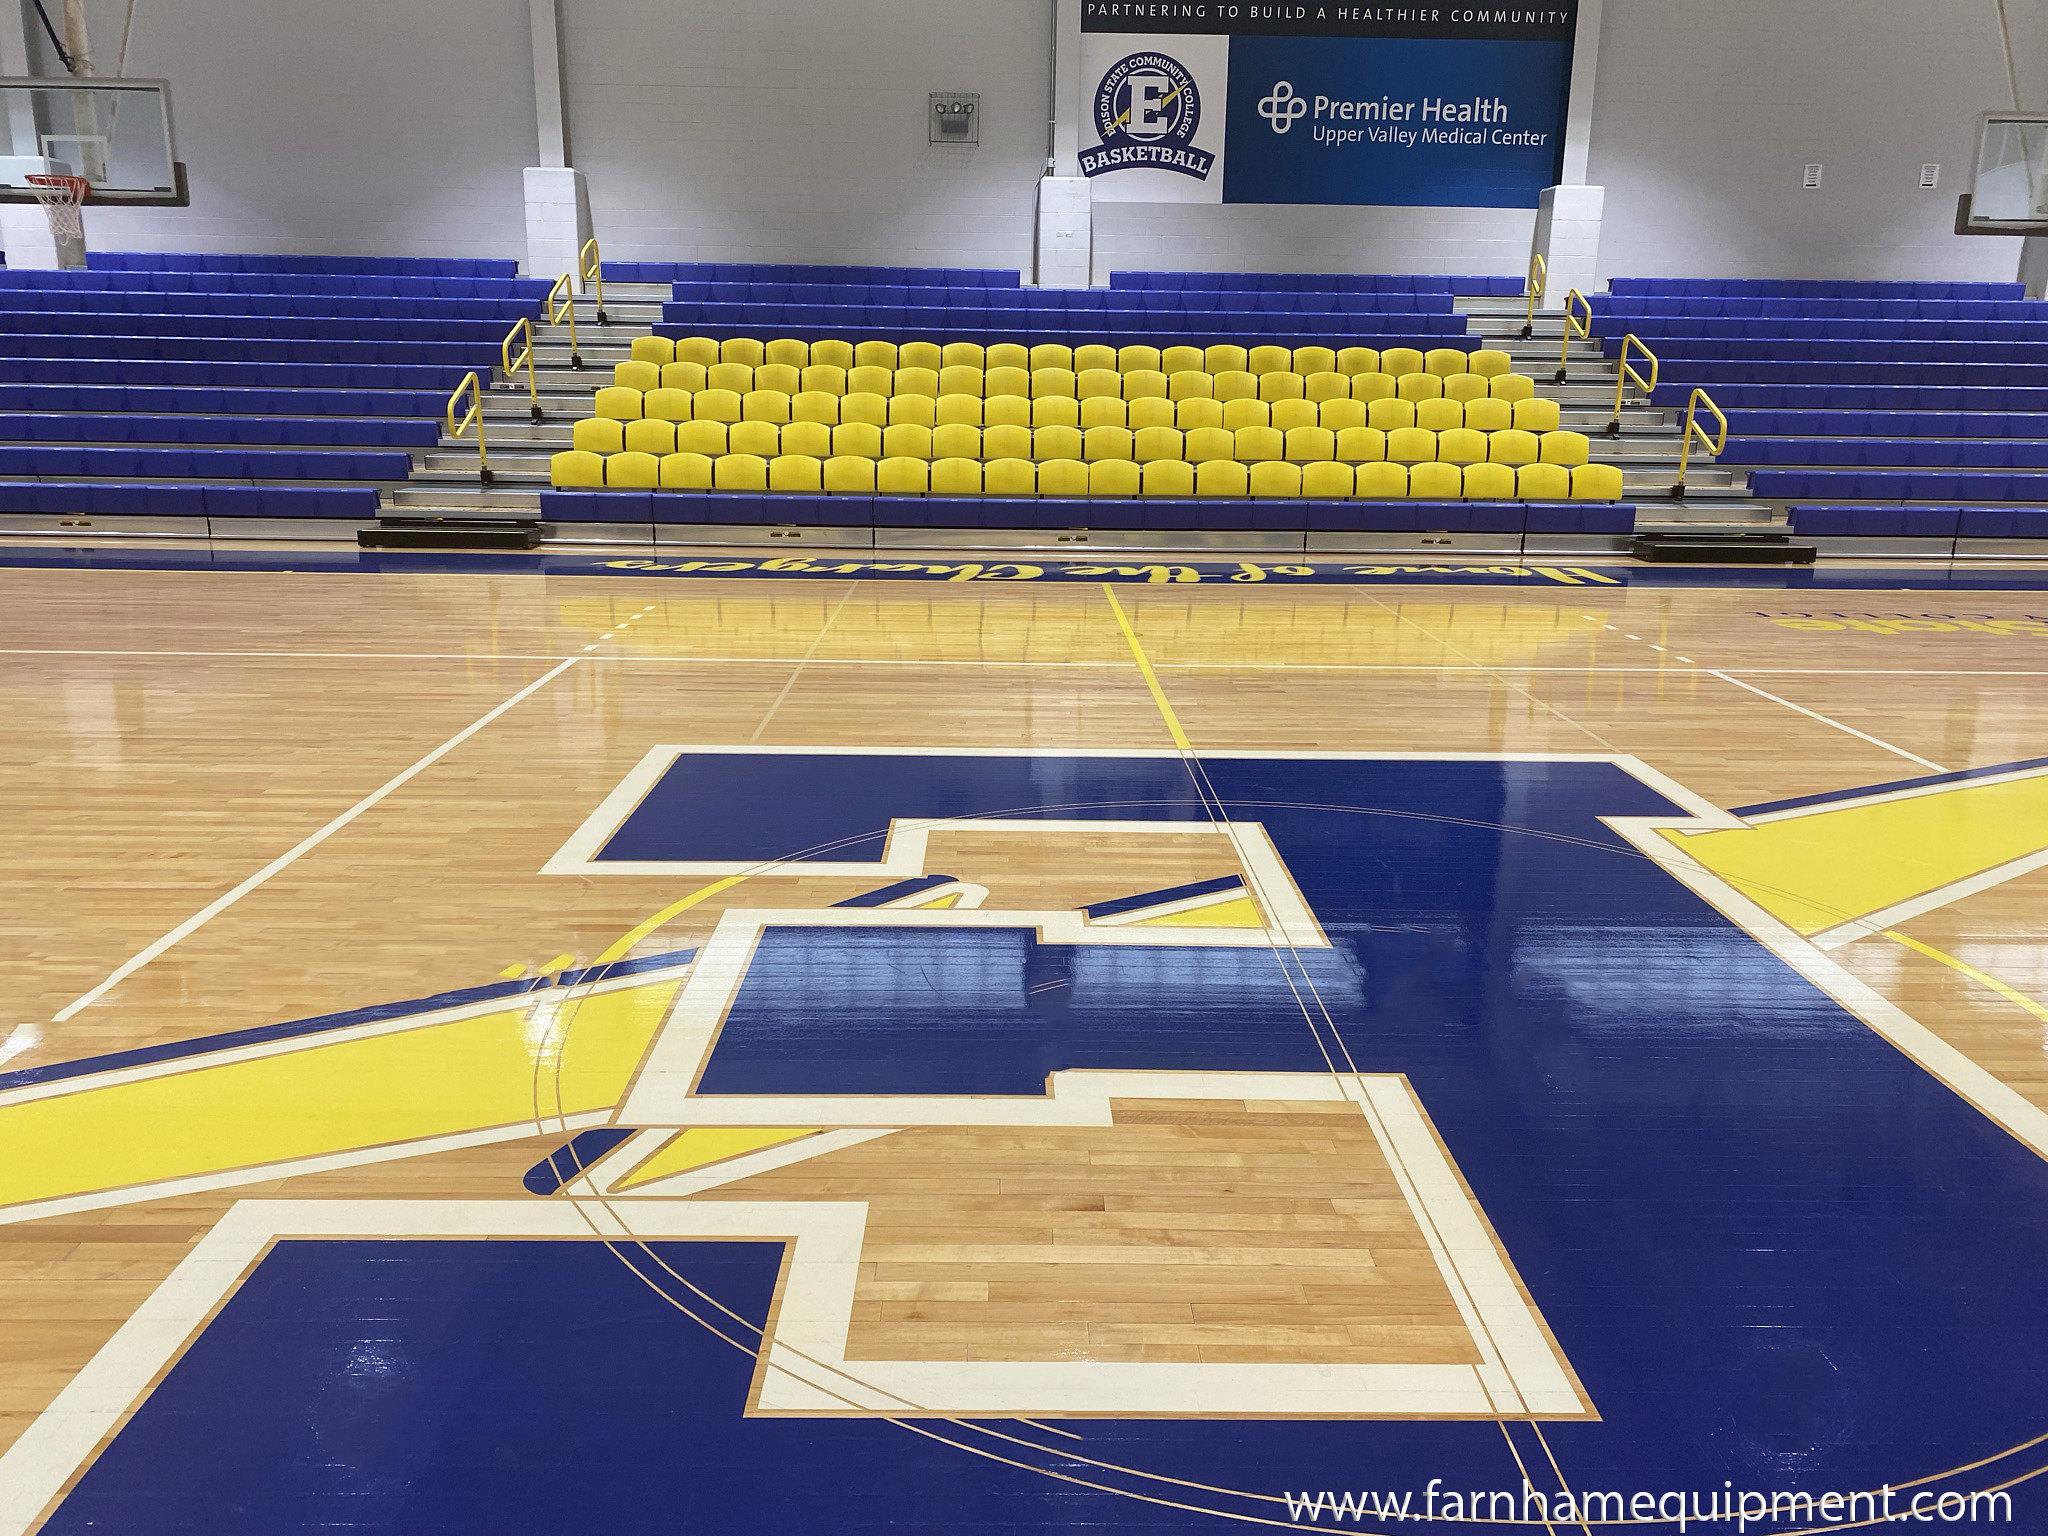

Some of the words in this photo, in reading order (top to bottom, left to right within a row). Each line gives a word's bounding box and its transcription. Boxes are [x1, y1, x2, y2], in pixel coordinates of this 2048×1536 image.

[1088, 3, 1206, 18] PARTNERING
[1217, 5, 1239, 18] TO
[1250, 6, 1306, 19] BUILD
[1316, 7, 1326, 20] A
[1338, 7, 1440, 22] HEALTHIER
[1450, 9, 1569, 24] COMMUNITY
[1103, 63, 1129, 93] STATE
[1128, 56, 1188, 87] COMMUNITY
[1100, 93, 1117, 138] EDISON
[1126, 75, 1170, 134] E
[1176, 87, 1194, 139] COLLEGE
[1314, 95, 1416, 121] Premier
[1421, 97, 1508, 123] Health
[1313, 125, 1365, 147] Upper
[1367, 126, 1418, 148] Valley
[1421, 127, 1488, 145] Medical
[1491, 128, 1548, 146] Center
[1081, 145, 1208, 174] BASKETBALL
[597, 558, 1045, 582] Chargers
[1060, 565, 1223, 585] the
[1230, 562, 1316, 582] of
[1342, 565, 1623, 585] Home
